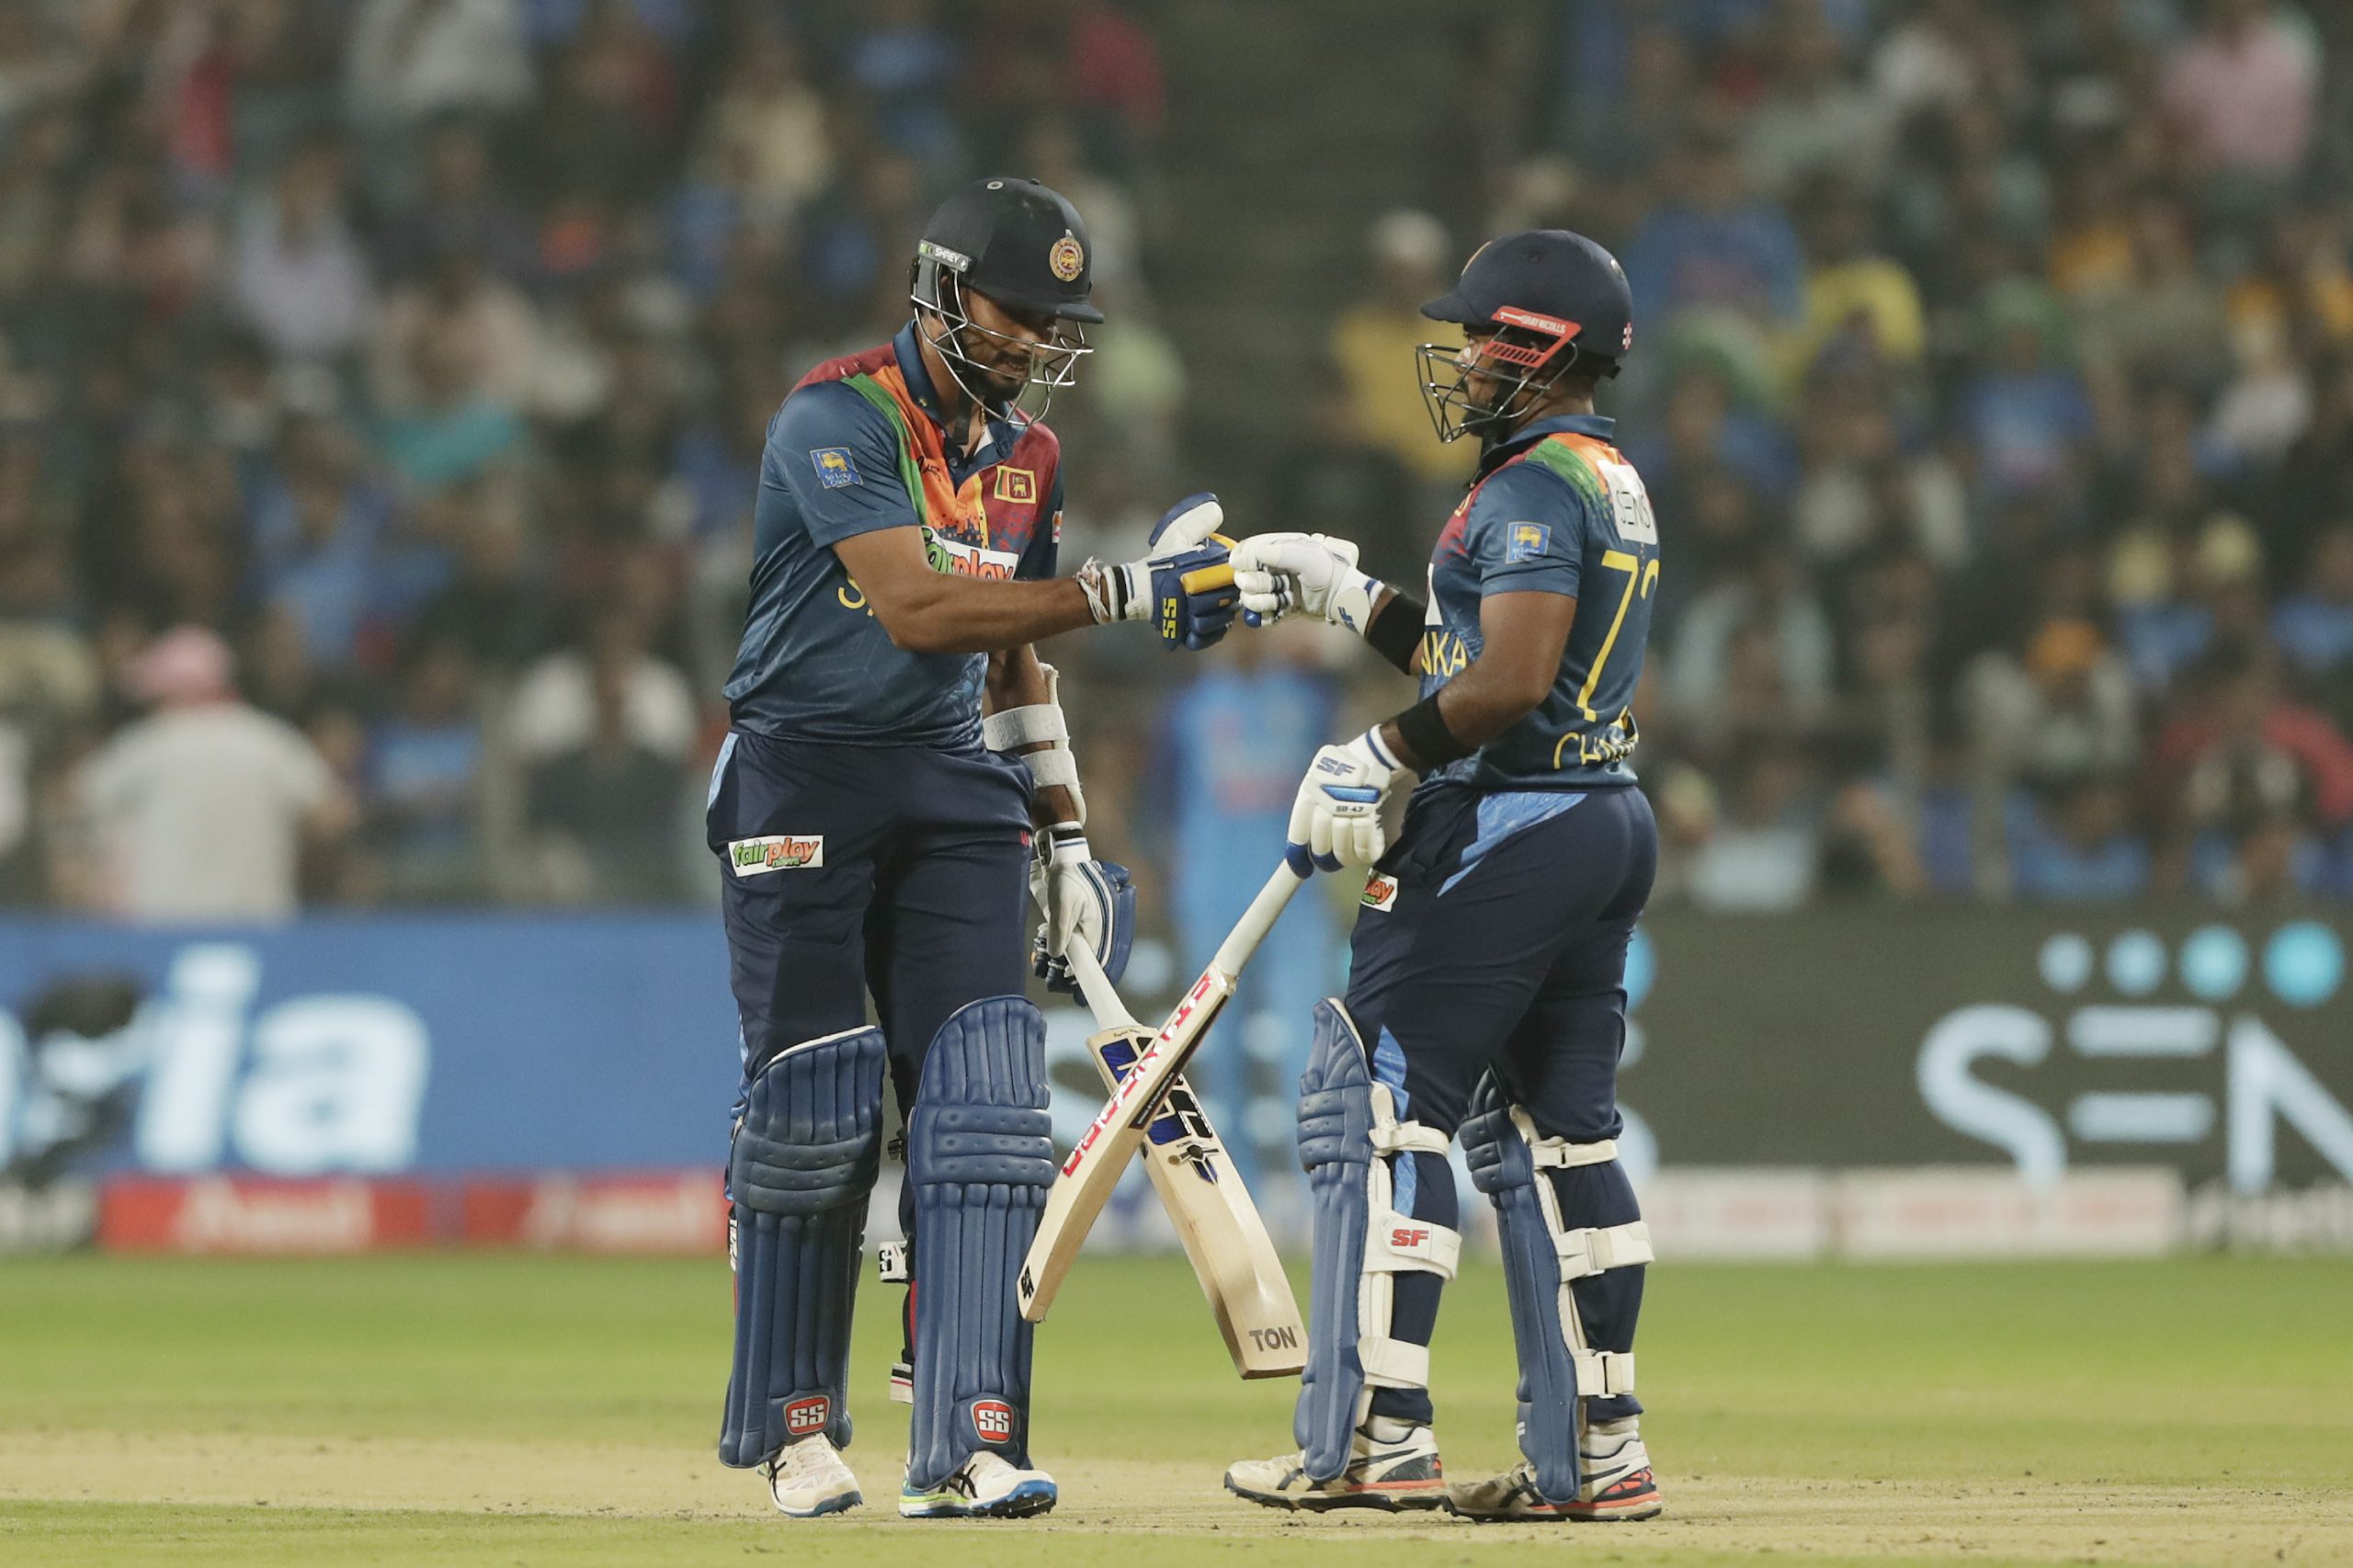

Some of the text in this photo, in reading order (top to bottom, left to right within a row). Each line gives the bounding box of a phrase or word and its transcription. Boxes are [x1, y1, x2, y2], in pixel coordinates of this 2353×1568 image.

[934, 246, 961, 264] SHREY
[1163, 597, 1177, 639] SS
[1316, 756, 1357, 777] SF
[733, 836, 820, 868] fairplay
[1392, 1228, 1429, 1247] SF
[1248, 1325, 1298, 1352] TON
[790, 1403, 824, 1428] SS
[978, 1409, 1009, 1434] SS
